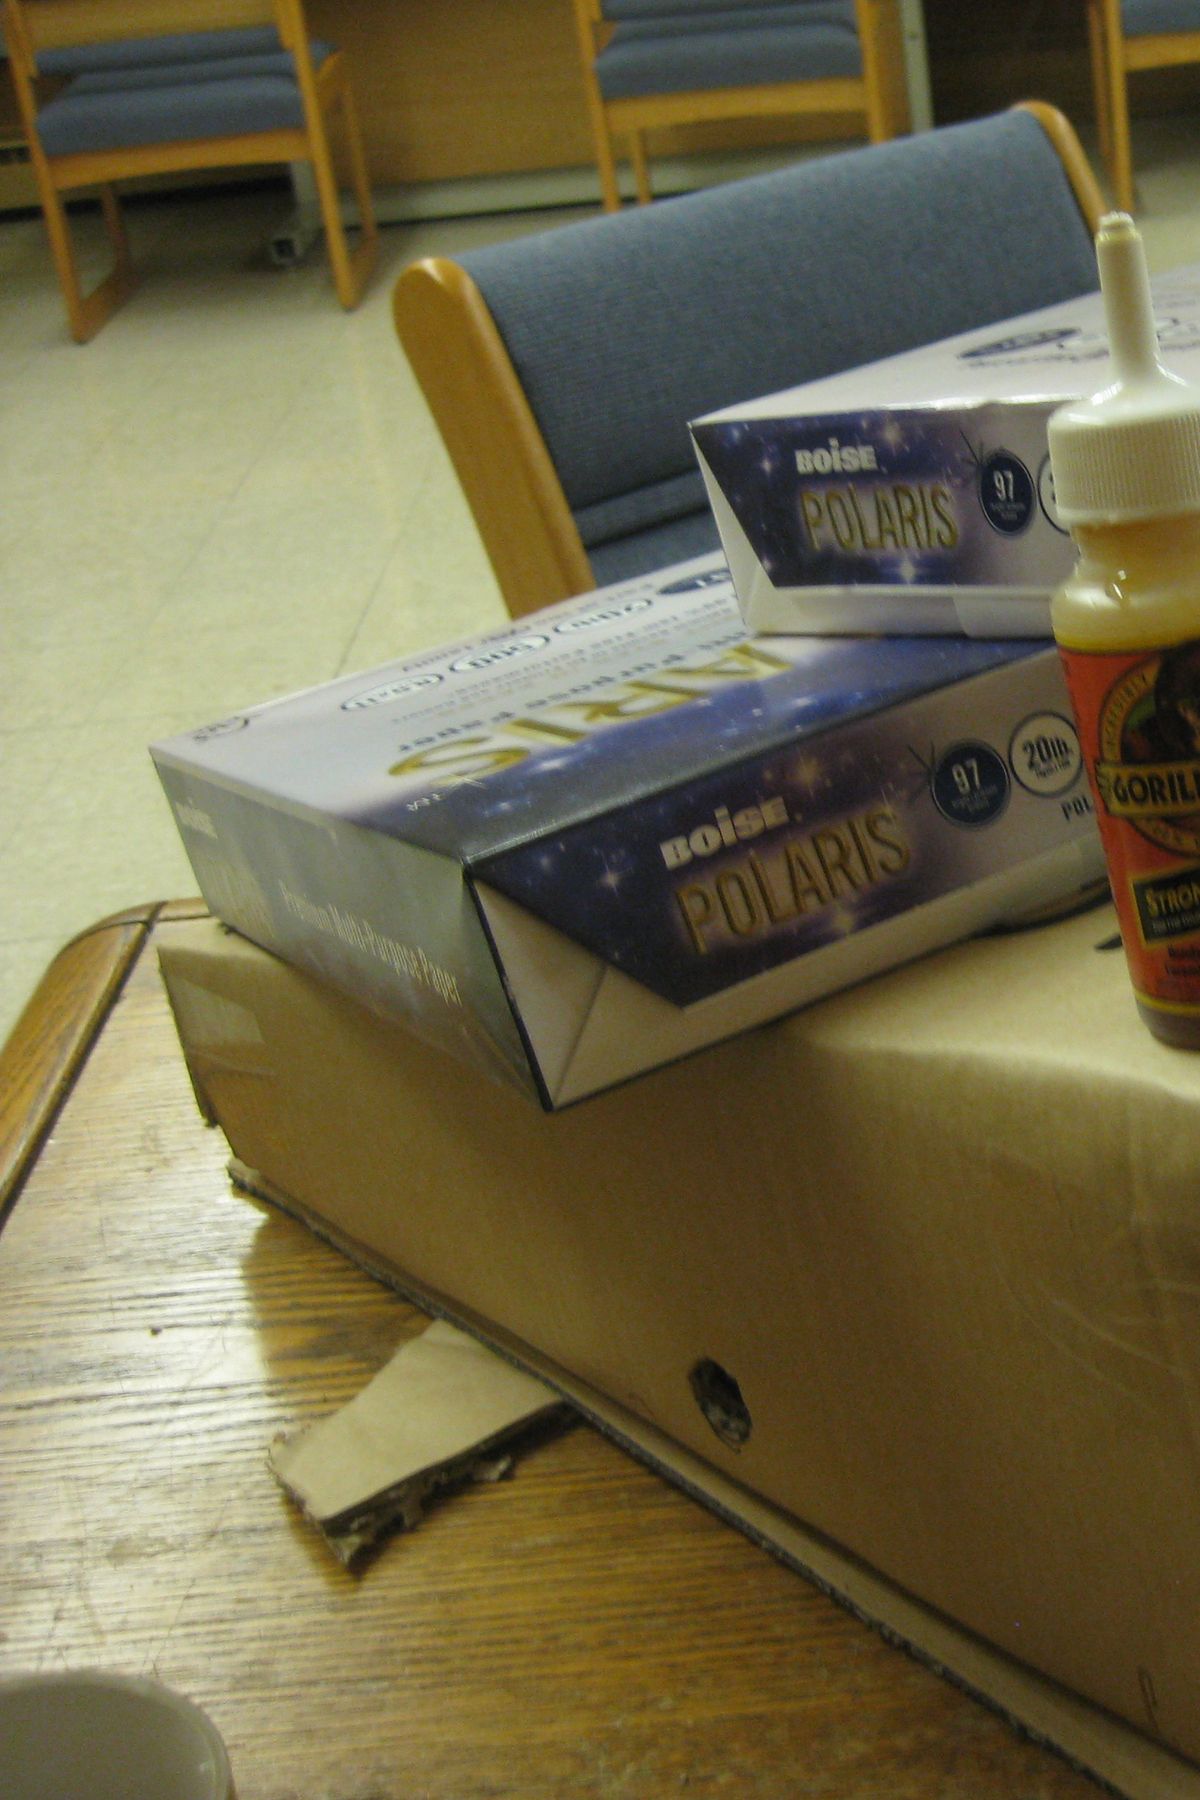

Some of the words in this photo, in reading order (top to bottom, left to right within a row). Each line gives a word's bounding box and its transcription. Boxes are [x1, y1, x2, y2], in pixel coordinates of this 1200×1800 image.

[802, 481, 958, 551] POLARIS
[388, 643, 794, 784] ARIS
[675, 806, 911, 956] POLARIS
